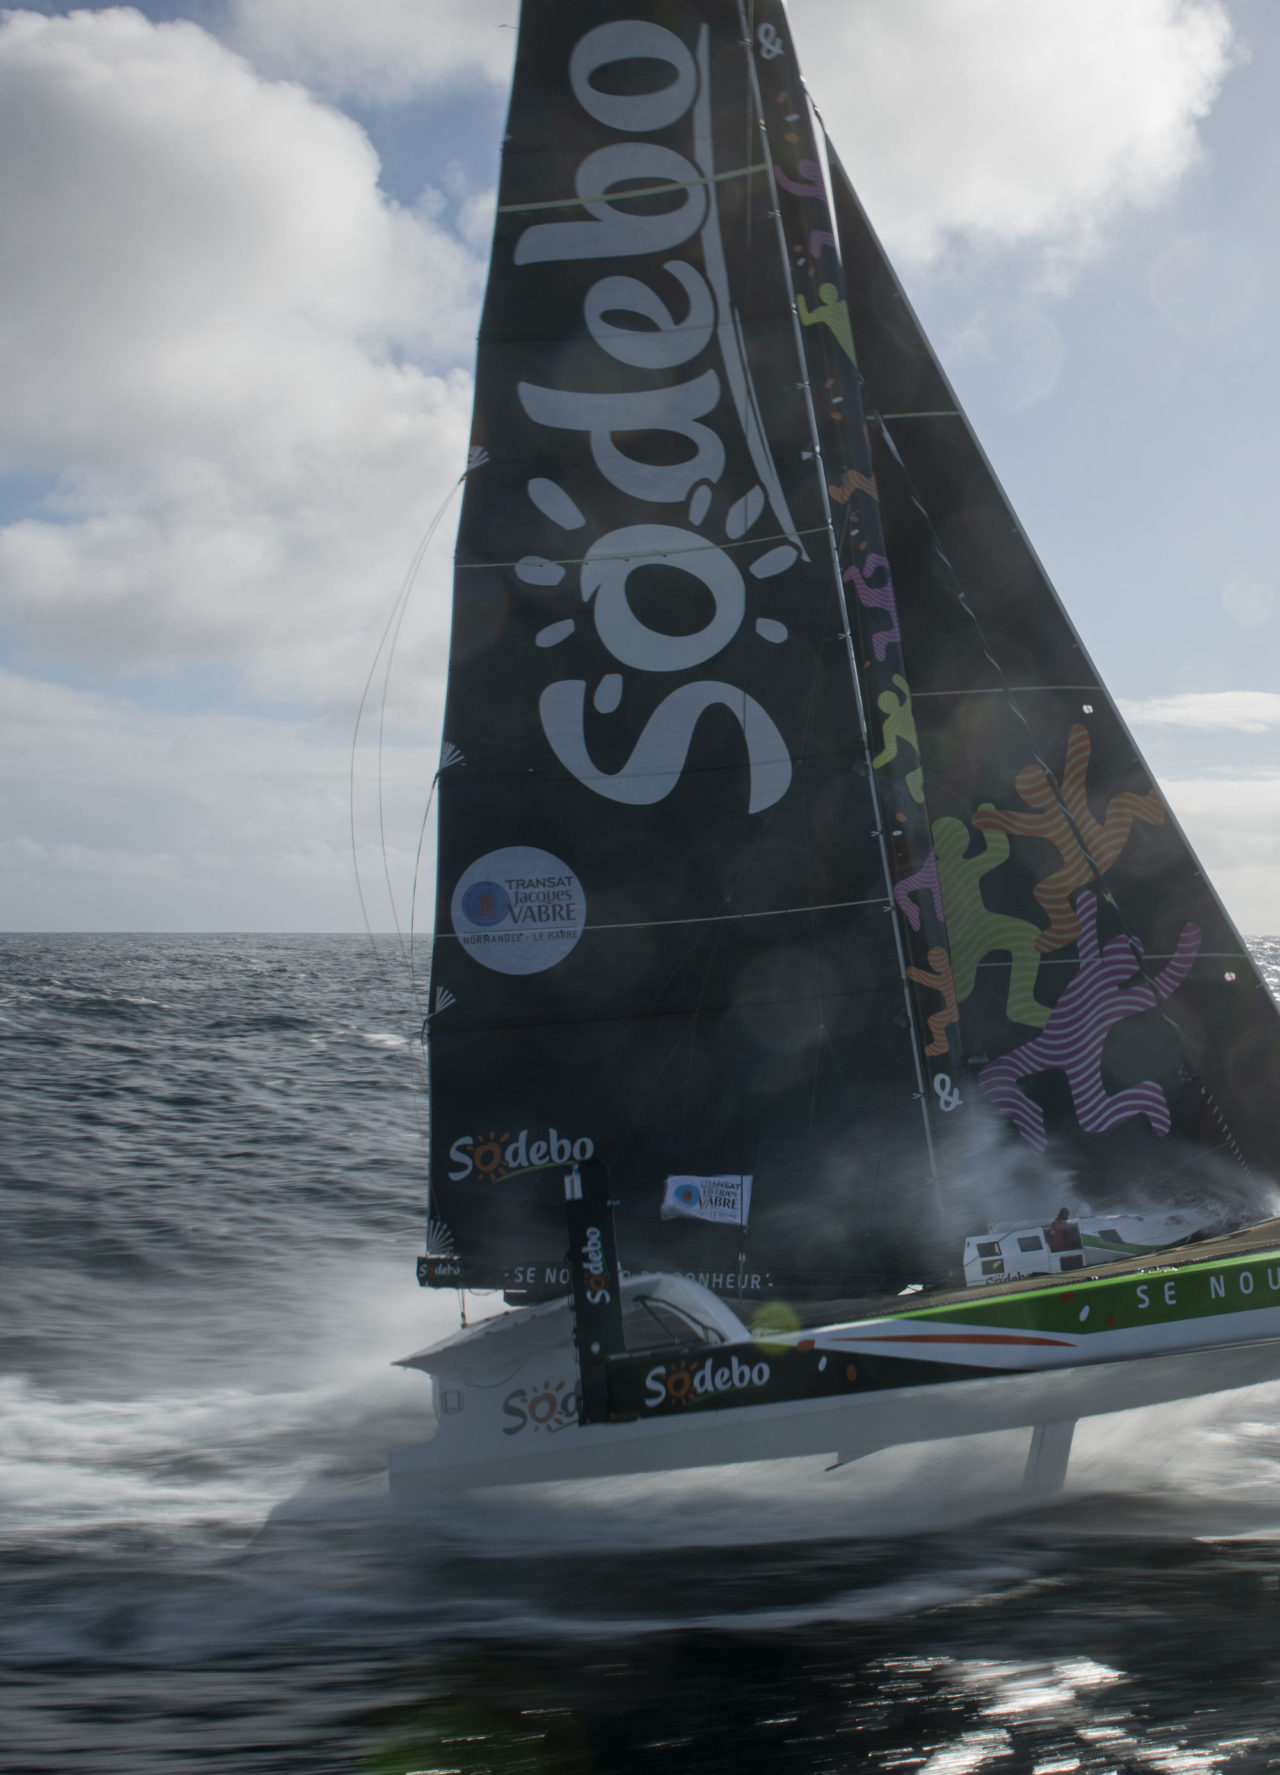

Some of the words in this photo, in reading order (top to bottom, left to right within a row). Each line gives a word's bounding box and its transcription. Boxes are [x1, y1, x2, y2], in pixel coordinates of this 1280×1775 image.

[757, 23, 785, 60] &
[512, 20, 793, 815] Sodebo
[505, 876, 574, 890] TRANSAT
[515, 889, 572, 906] Jacques
[508, 902, 577, 924] VABRE
[934, 1073, 963, 1112] &
[448, 1128, 594, 1182] Sodebo
[514, 1267, 536, 1284] SE
[582, 1226, 611, 1305] Sodebo
[1136, 1281, 1178, 1309] SE
[644, 1355, 771, 1408] Sodebo
